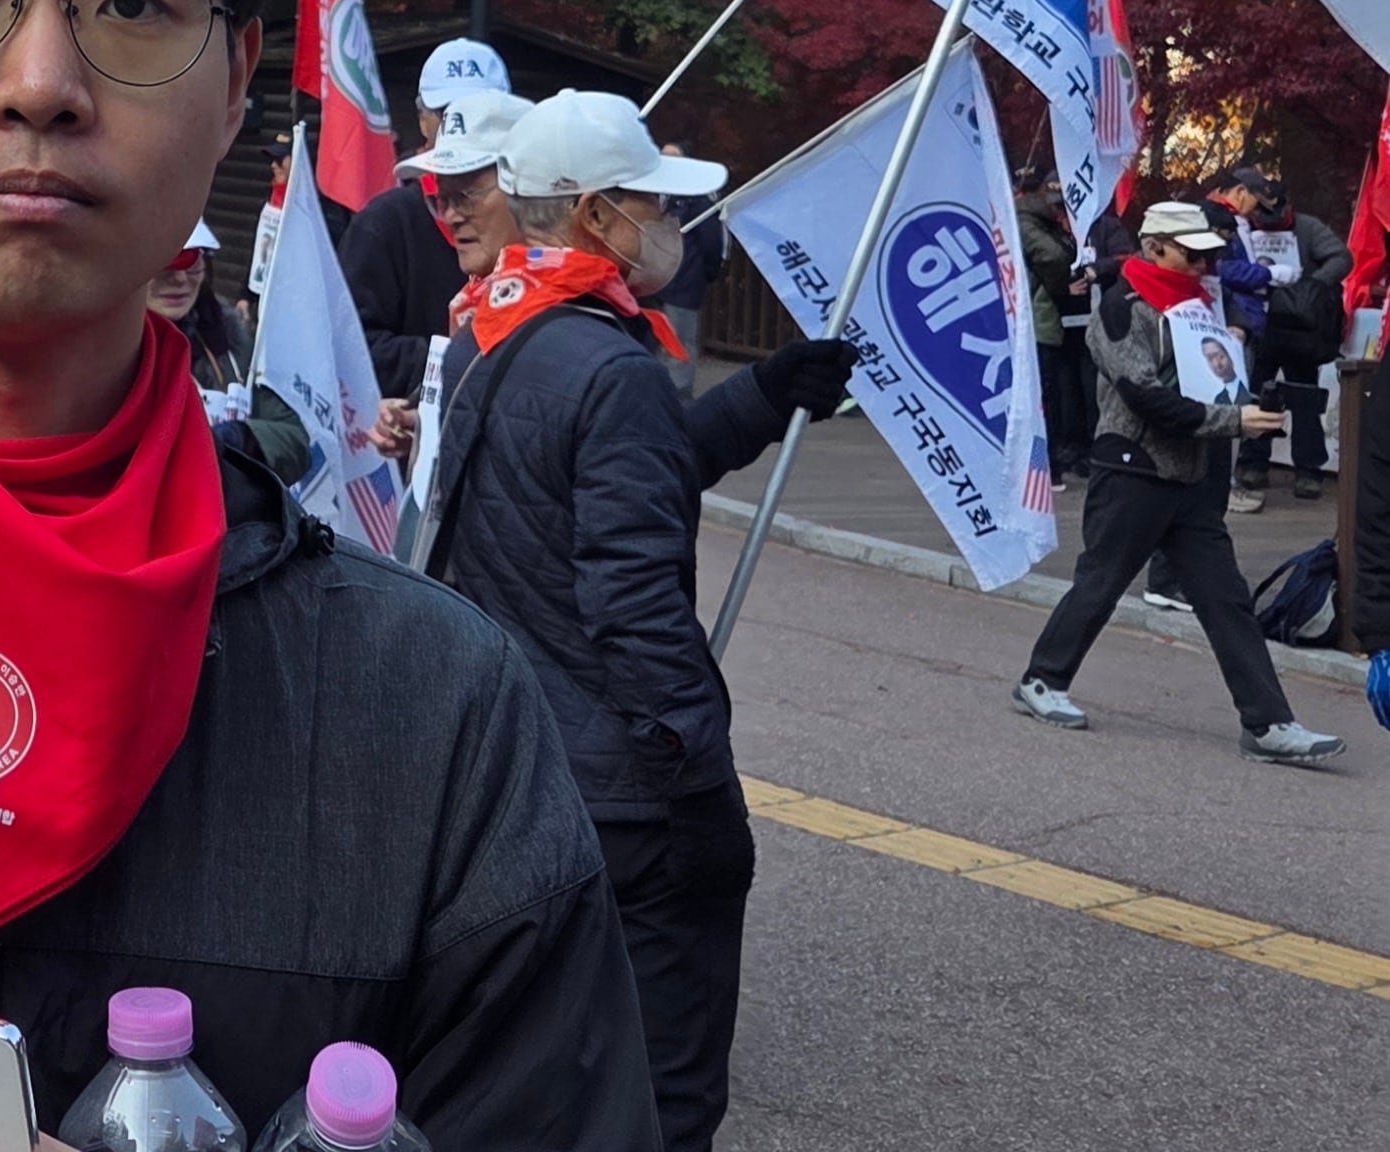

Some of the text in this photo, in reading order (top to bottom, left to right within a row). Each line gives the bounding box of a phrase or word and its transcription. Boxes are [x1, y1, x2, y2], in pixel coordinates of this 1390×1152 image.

[445, 59, 485, 79] NA
[892, 391, 998, 538] 구국동지회
[0, 663, 27, 699] 이승만
